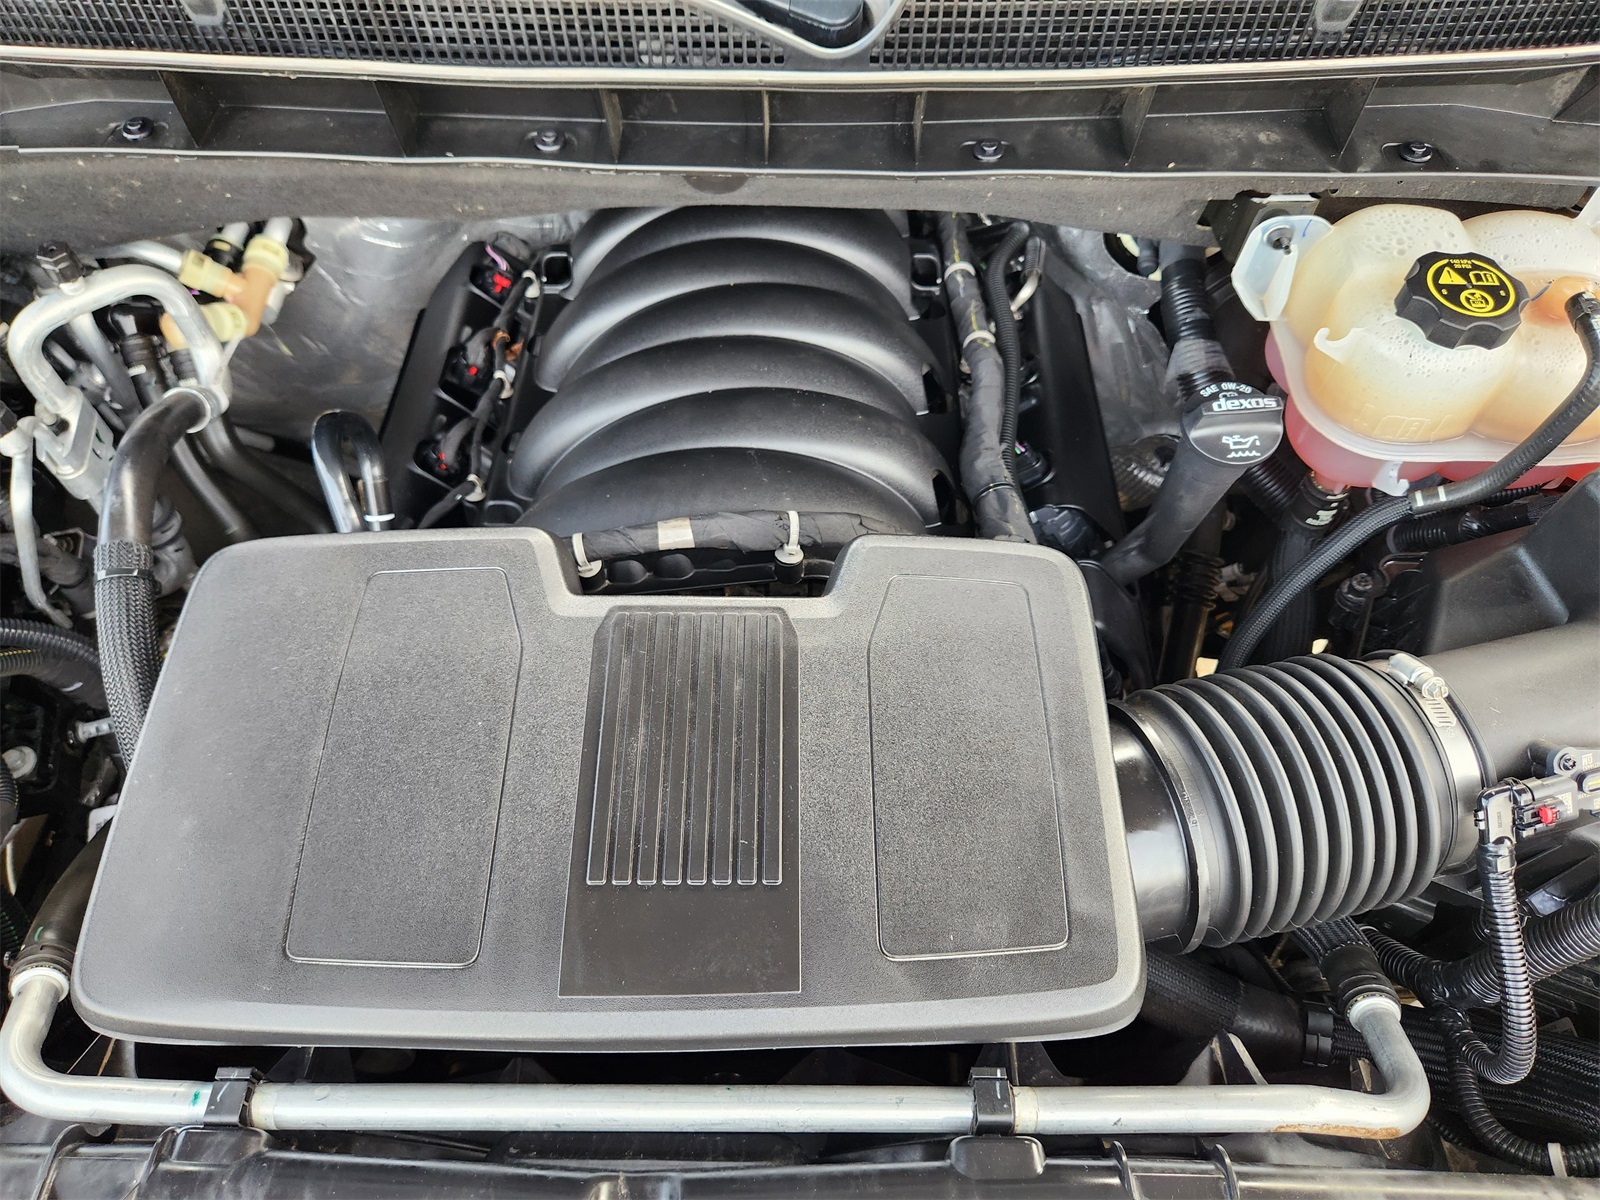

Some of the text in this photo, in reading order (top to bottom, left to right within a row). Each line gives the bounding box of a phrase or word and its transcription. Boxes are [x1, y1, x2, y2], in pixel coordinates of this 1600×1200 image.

[1200, 382, 1253, 397] SAE 0W-20
[1212, 398, 1277, 411] dexos
